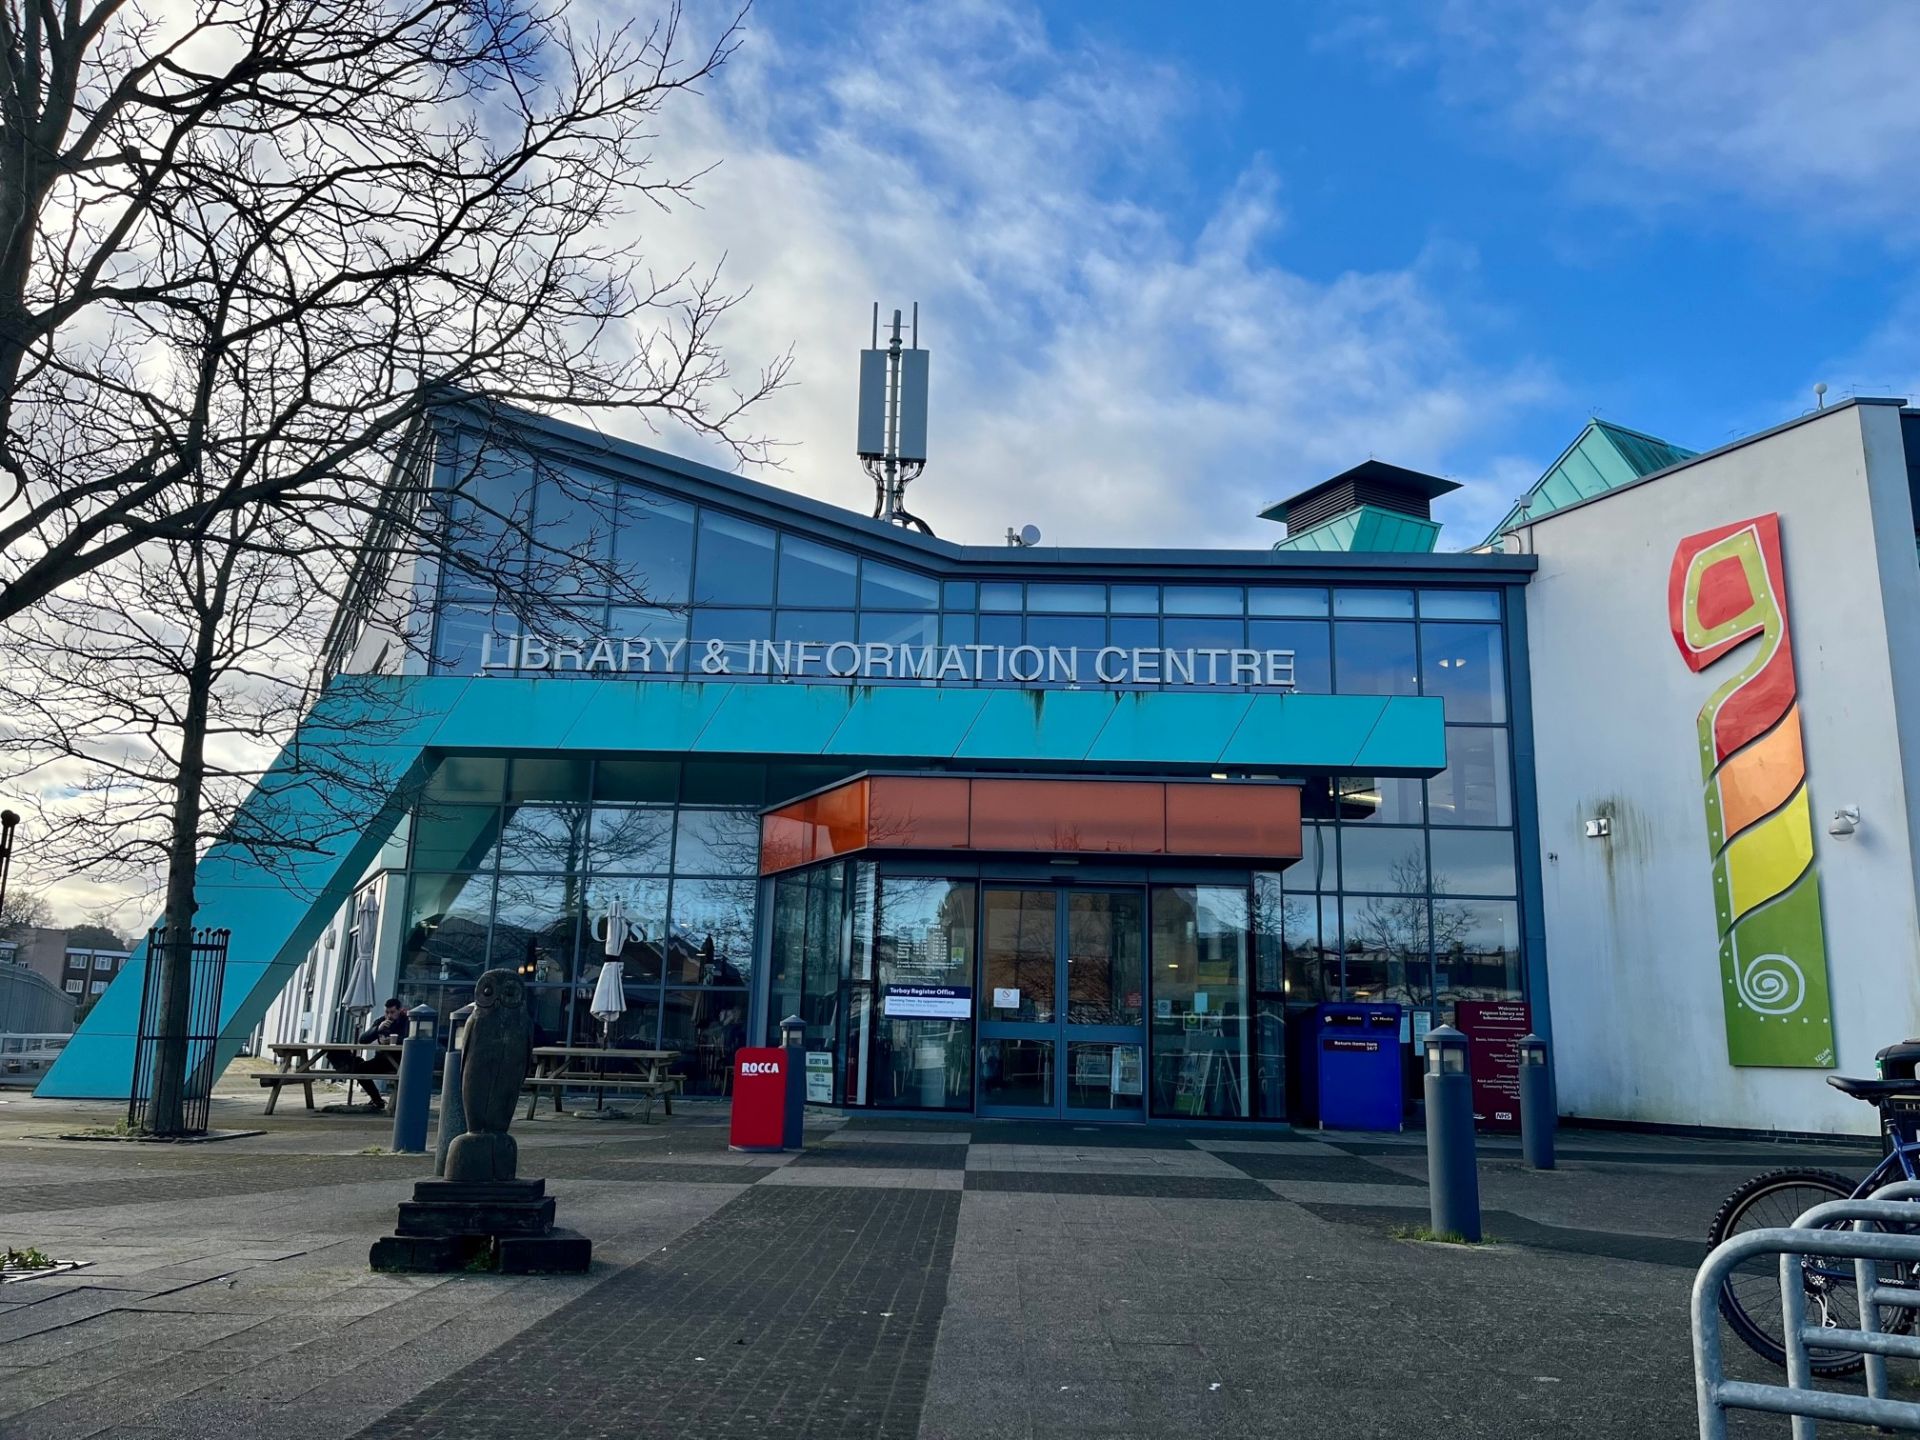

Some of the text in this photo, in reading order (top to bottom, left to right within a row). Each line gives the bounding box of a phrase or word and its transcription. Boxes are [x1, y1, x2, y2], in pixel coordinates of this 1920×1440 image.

[481, 633, 1296, 686] LIBRARY & INFORMATION CENTRE
[741, 1062, 780, 1073] ROCCA
